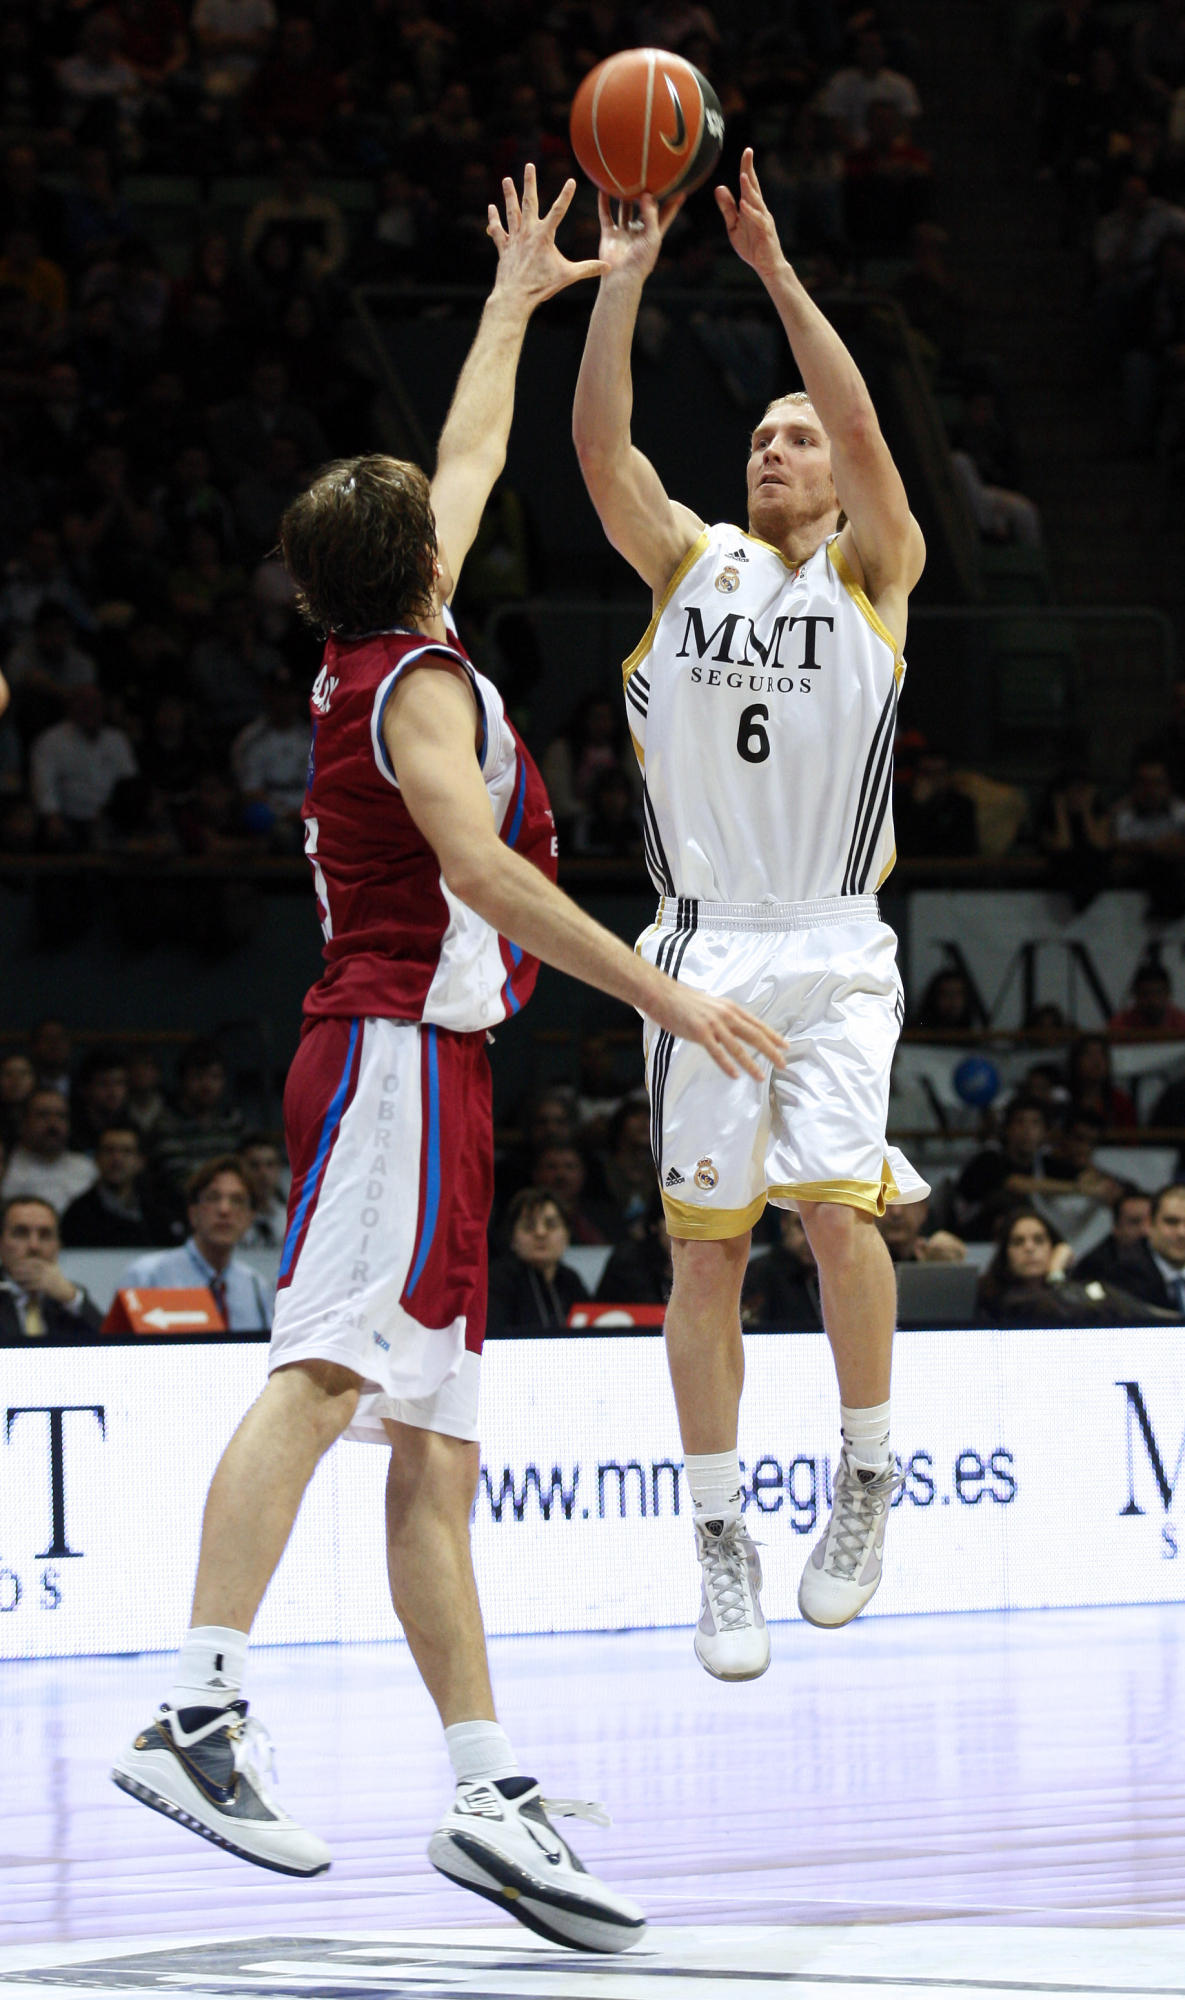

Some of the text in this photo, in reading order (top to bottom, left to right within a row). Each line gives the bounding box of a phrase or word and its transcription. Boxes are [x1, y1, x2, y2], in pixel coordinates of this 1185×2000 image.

[676, 606, 834, 670] MMT
[690, 667, 812, 694] SEGUROS
[736, 702, 771, 764] 6
